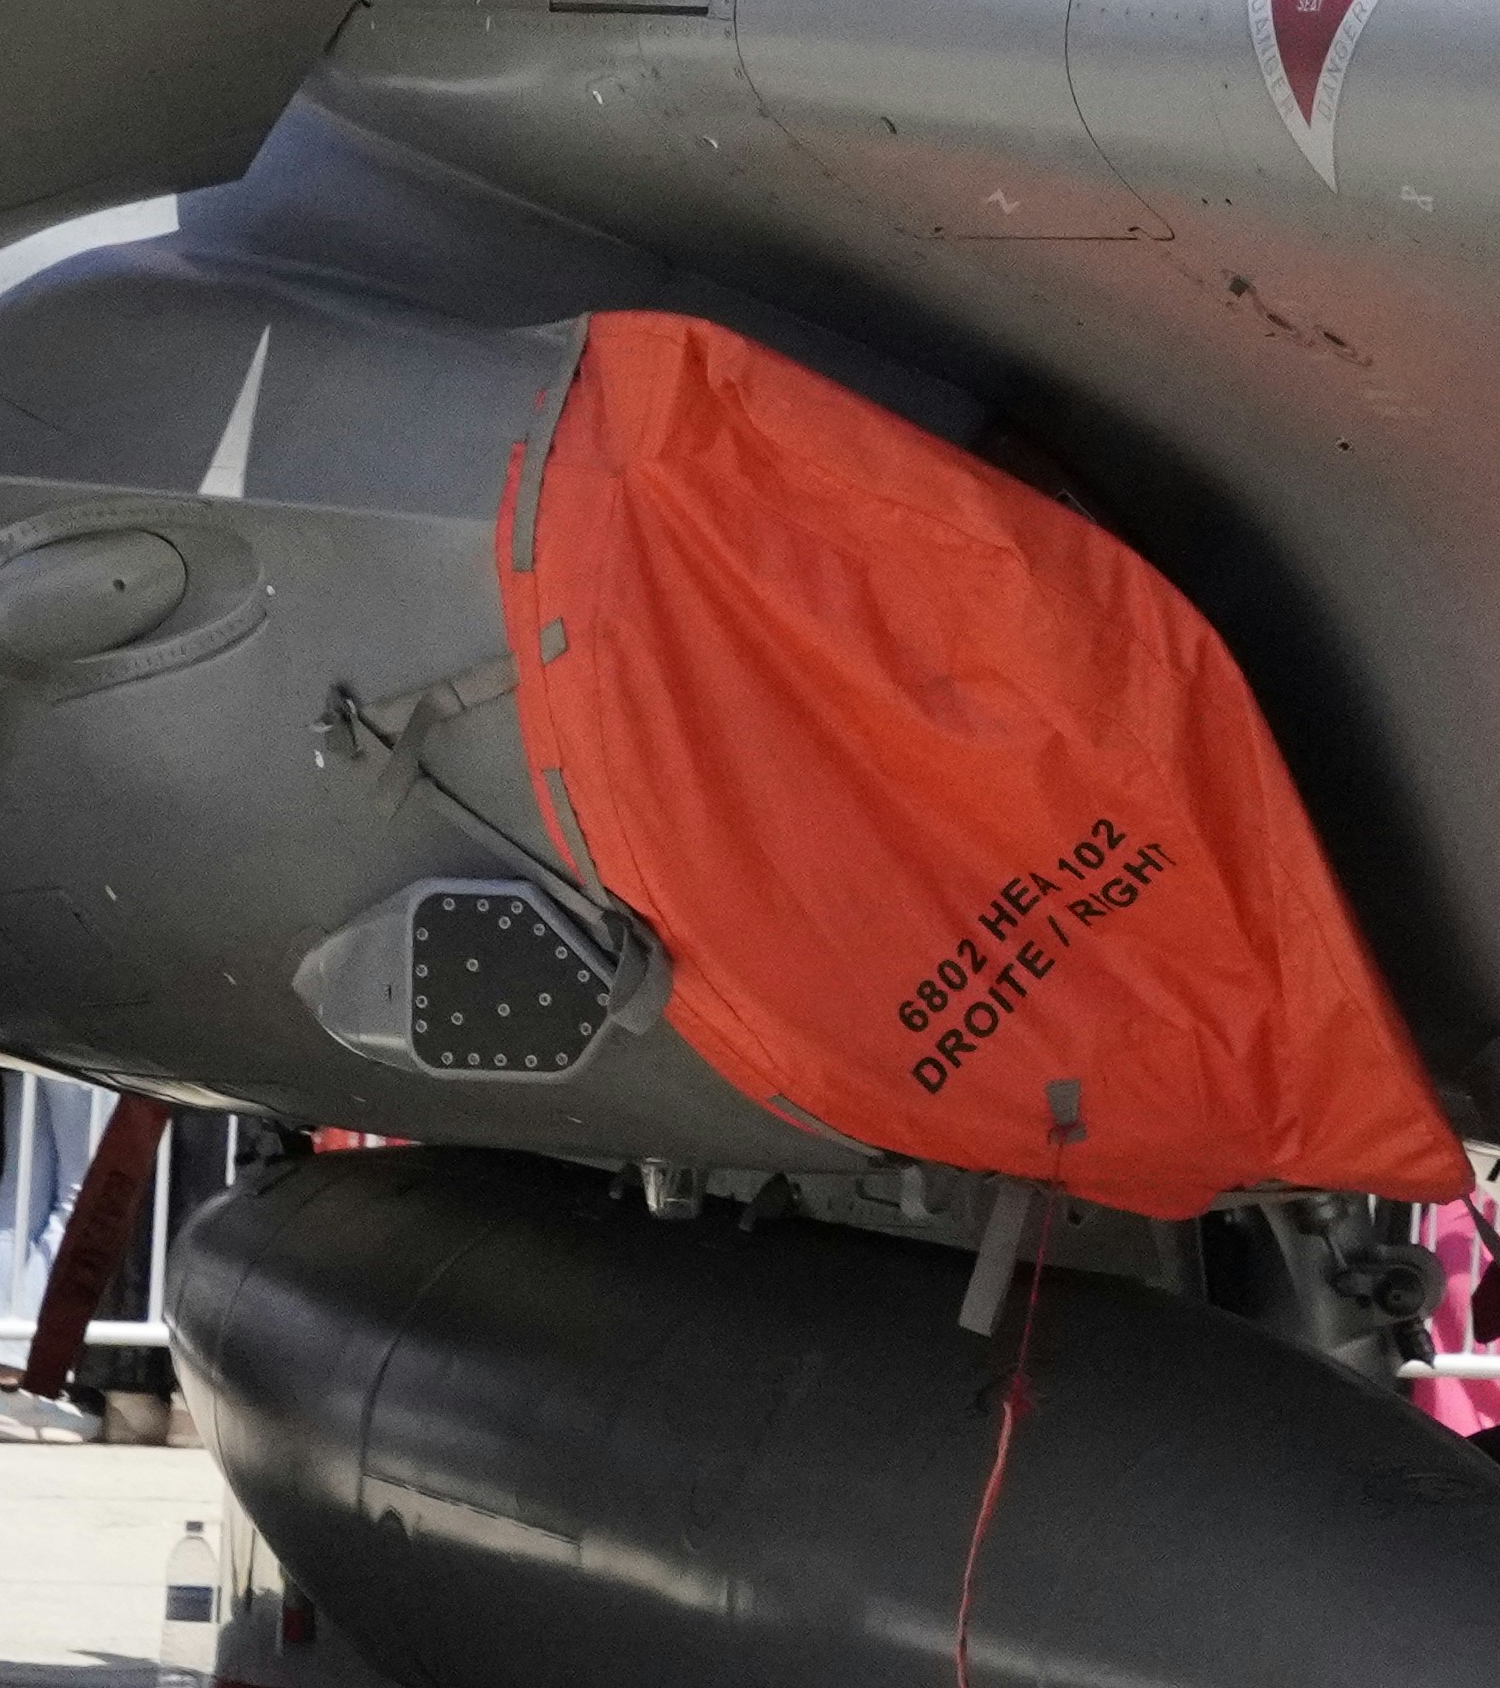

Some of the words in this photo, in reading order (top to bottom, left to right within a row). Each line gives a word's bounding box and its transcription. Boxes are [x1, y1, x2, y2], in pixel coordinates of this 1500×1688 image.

[1317, 0, 1371, 123] DANGER
[897, 937, 991, 1034] 6802
[978, 871, 1062, 942] HEA
[1057, 818, 1127, 882] 102
[910, 939, 1057, 1096] DROITE
[1065, 842, 1178, 928] RIGHT
